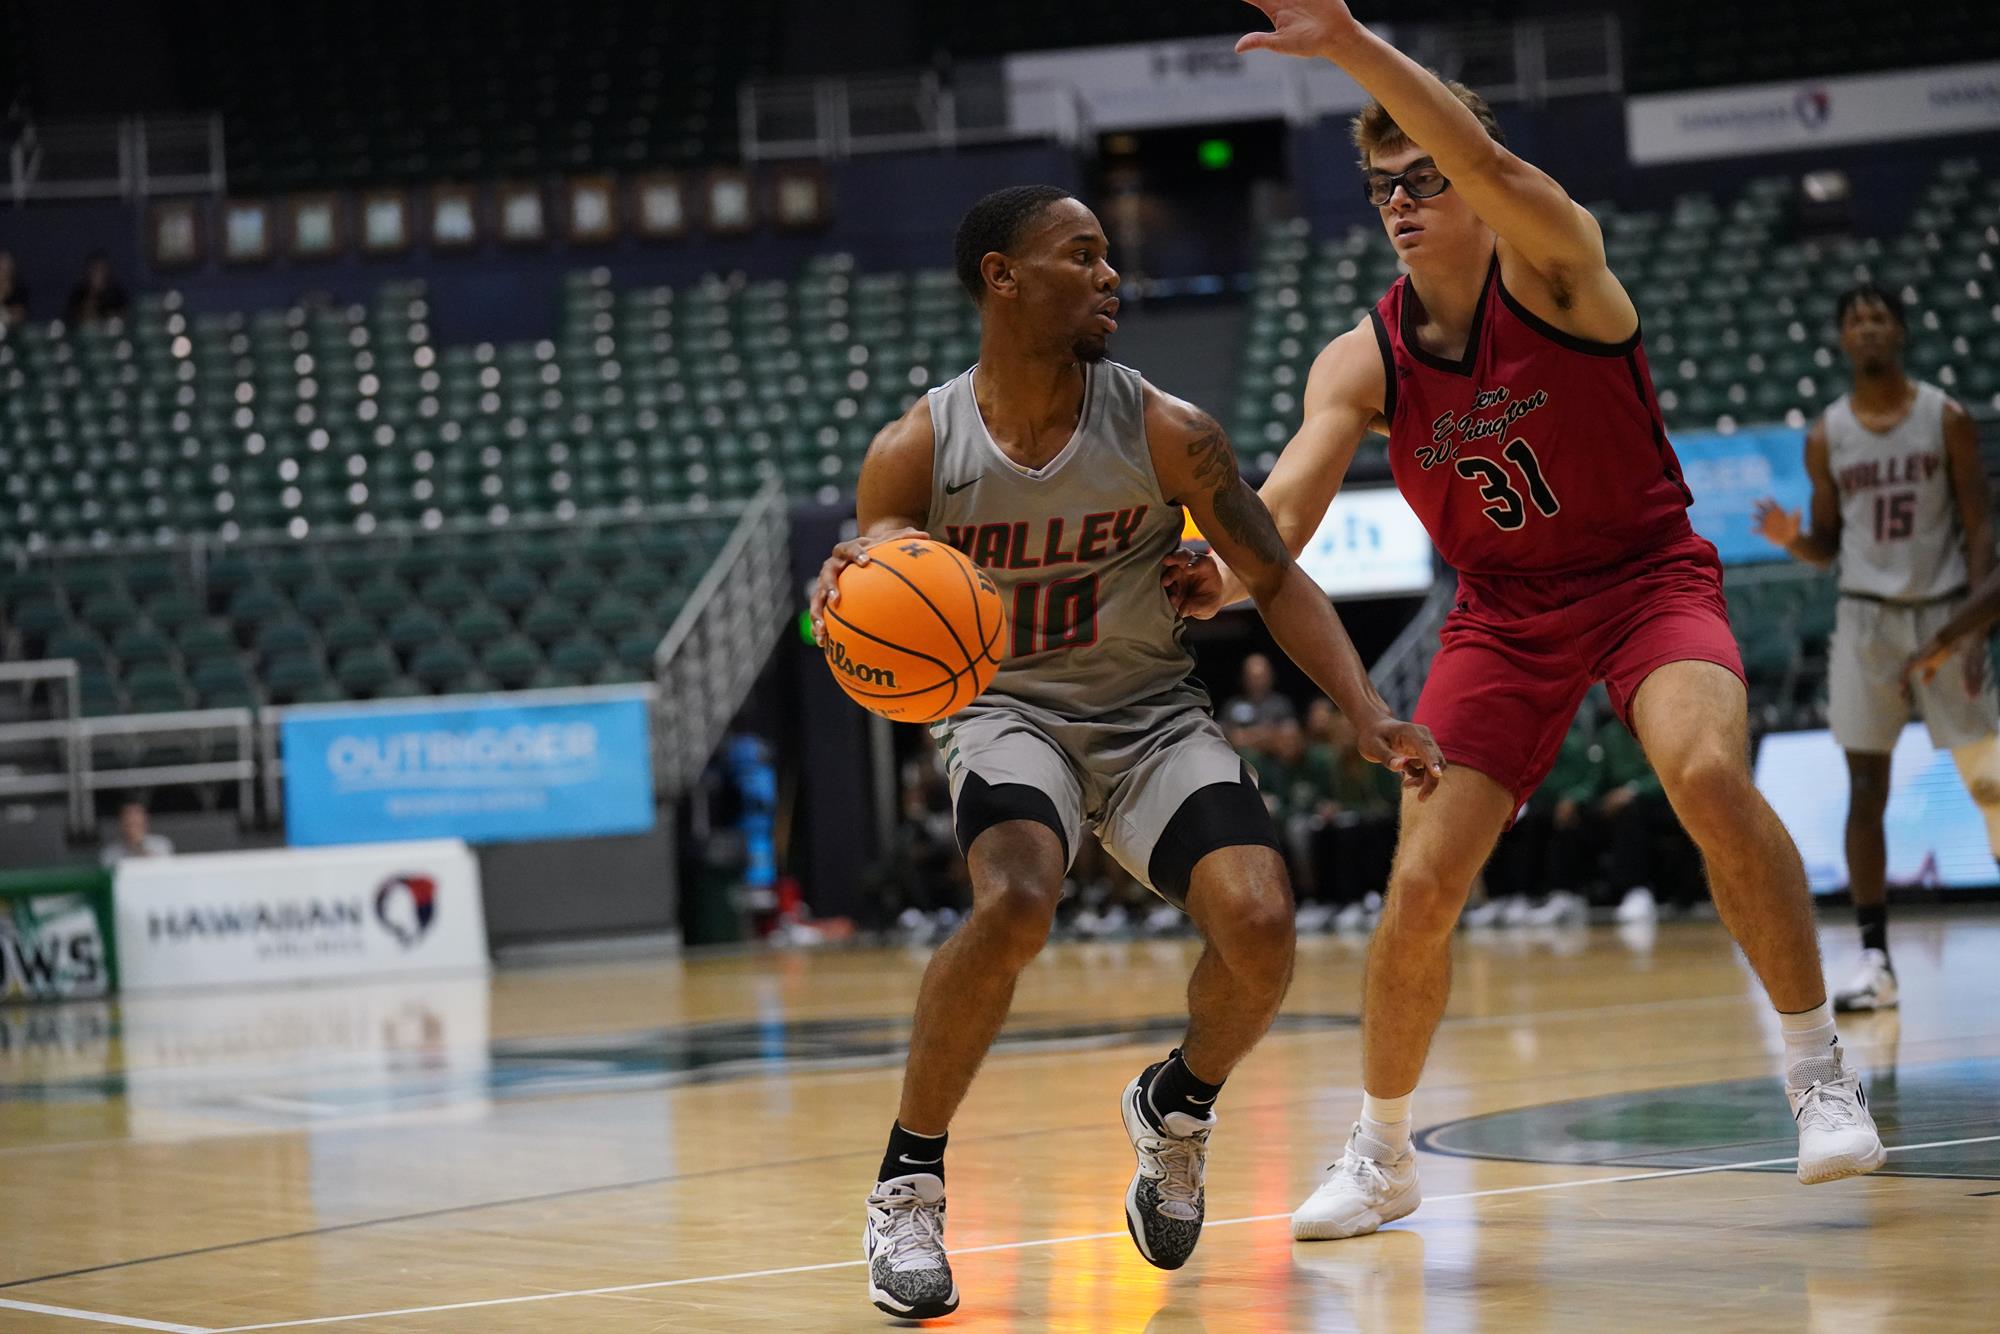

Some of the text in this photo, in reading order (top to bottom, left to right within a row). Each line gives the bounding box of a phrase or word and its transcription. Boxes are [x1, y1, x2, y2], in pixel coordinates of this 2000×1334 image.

[1454, 436, 1561, 532] 31
[1874, 490, 1917, 544] 15
[945, 504, 1149, 570] VALLEY
[1011, 572, 1099, 659] 10
